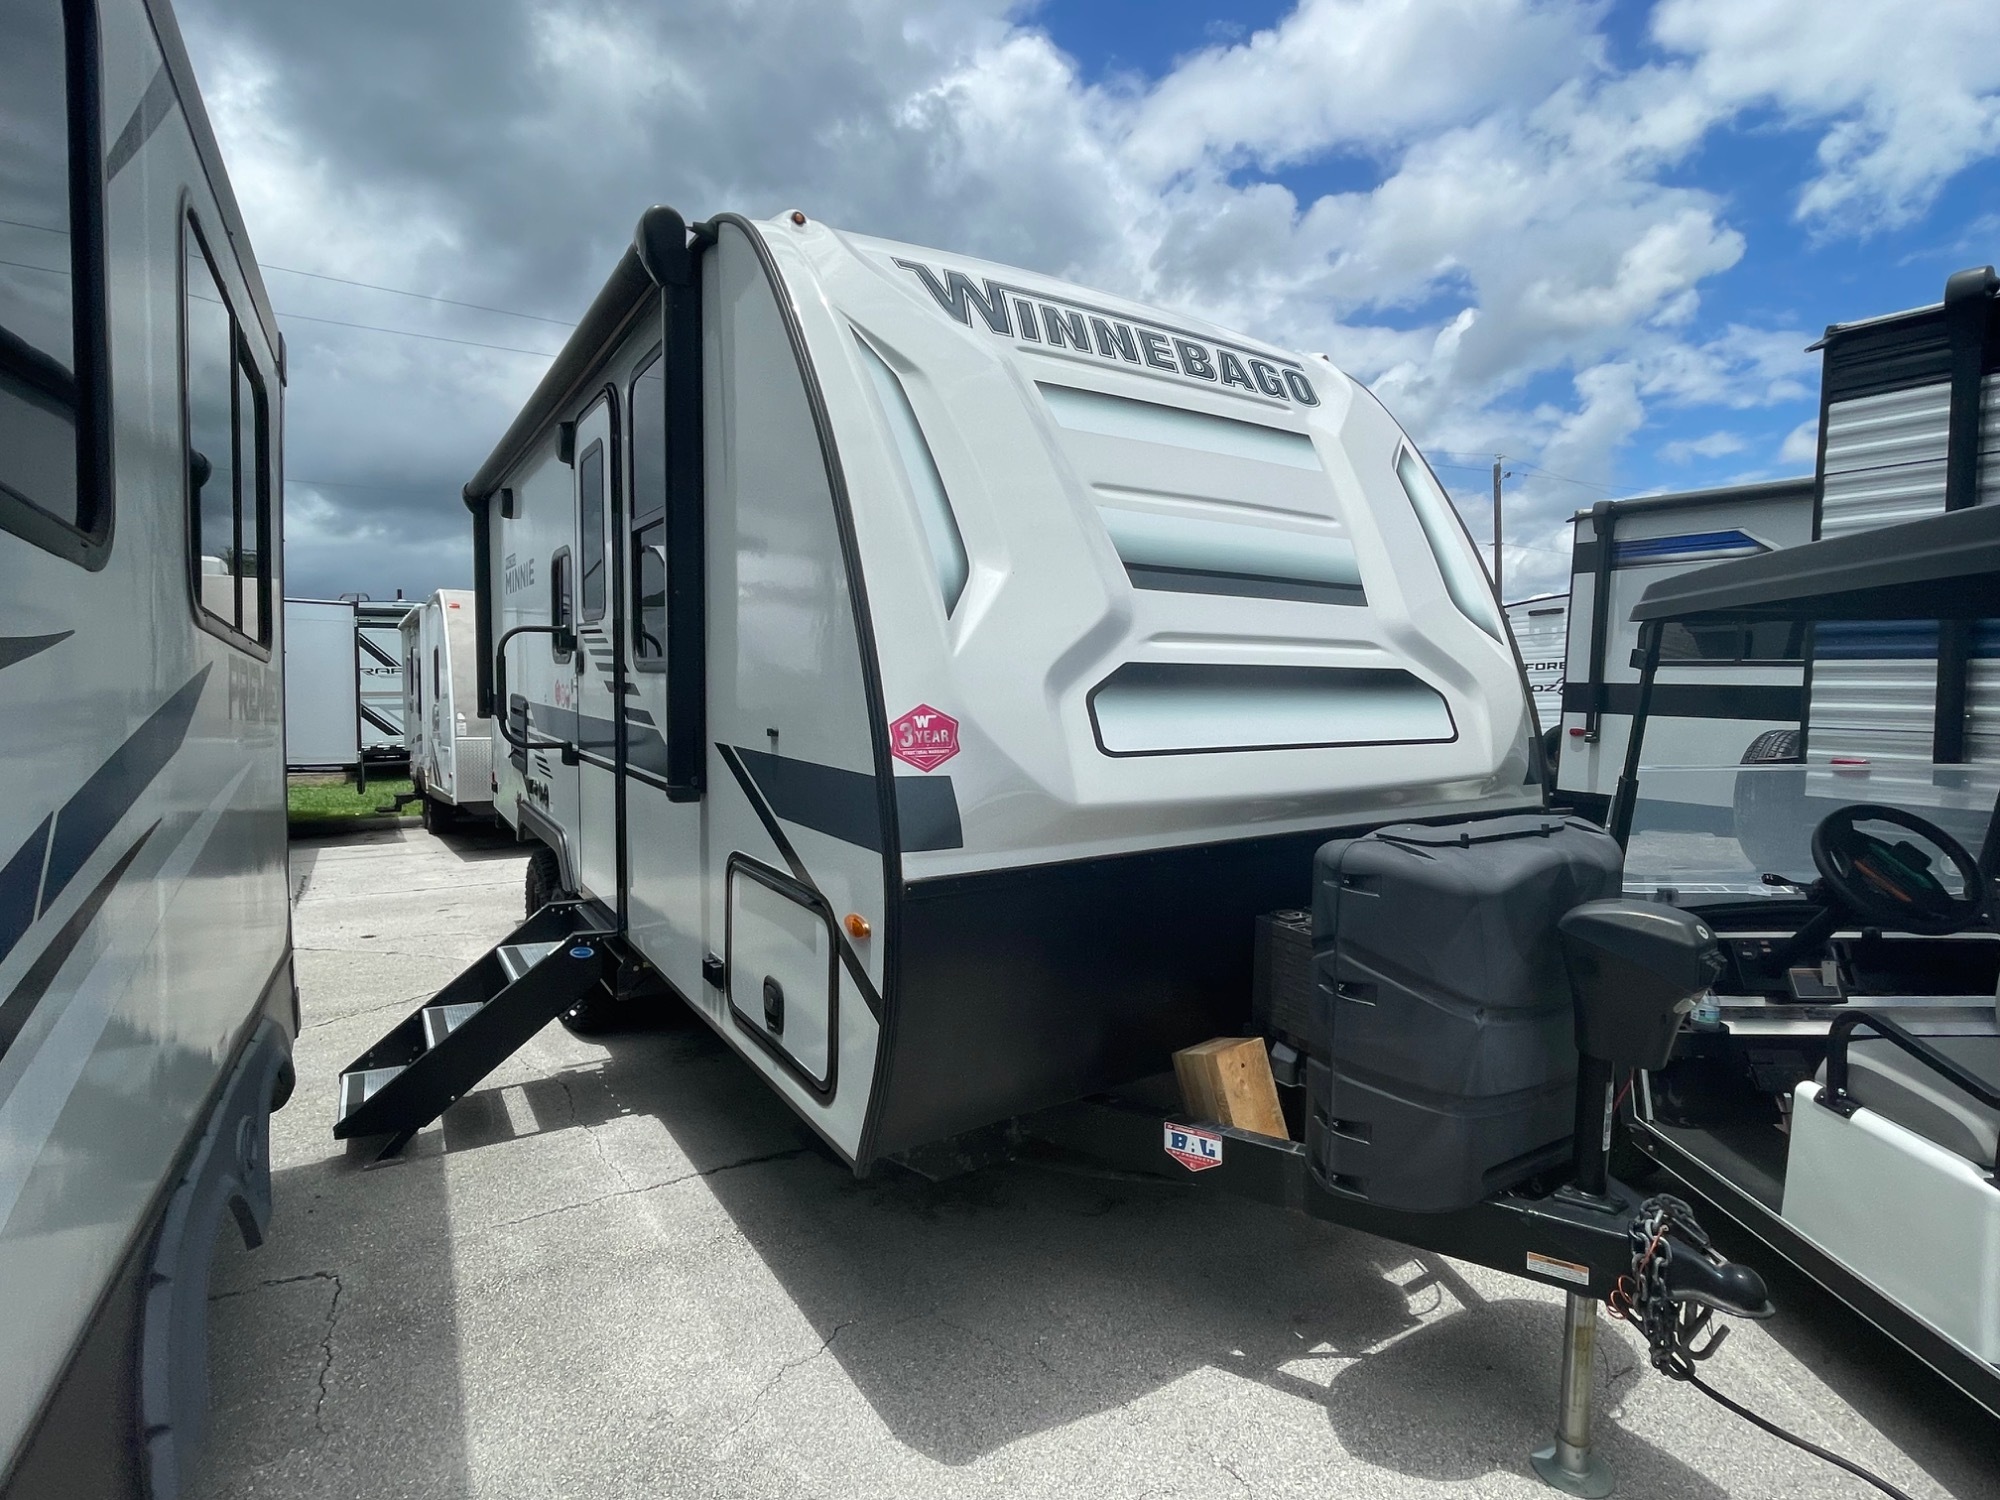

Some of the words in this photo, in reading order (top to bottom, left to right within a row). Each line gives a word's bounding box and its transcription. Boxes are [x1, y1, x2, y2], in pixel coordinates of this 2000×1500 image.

[890, 257, 1321, 408] WINNEBAGO
[505, 558, 535, 595] MINNIE
[899, 722, 914, 748] 3
[914, 729, 950, 744] YEAR
[1171, 1132, 1216, 1158] BAL
